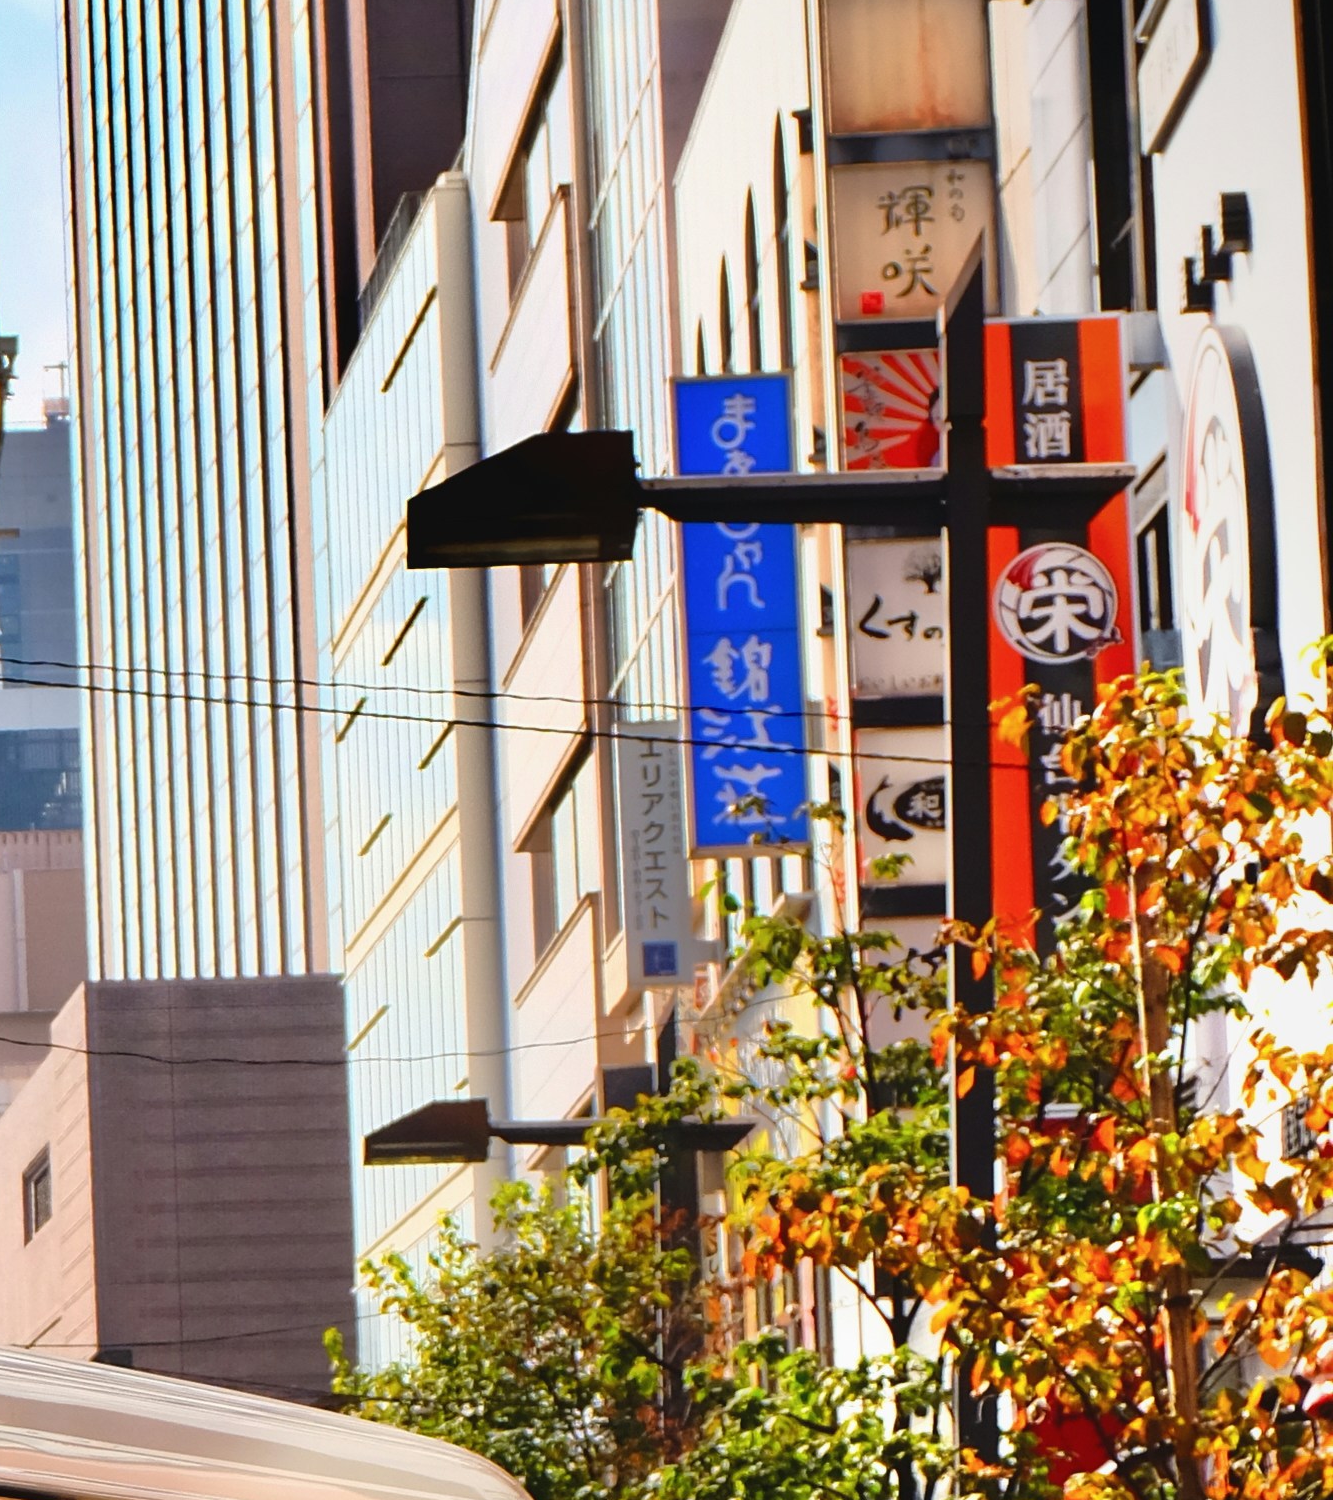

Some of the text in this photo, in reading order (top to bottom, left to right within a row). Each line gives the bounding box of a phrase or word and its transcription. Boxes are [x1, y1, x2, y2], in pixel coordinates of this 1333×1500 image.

[876, 184, 939, 299] 輝咲
[1017, 567, 1106, 654] 栄
[639, 739, 671, 929] エリアクエスト
